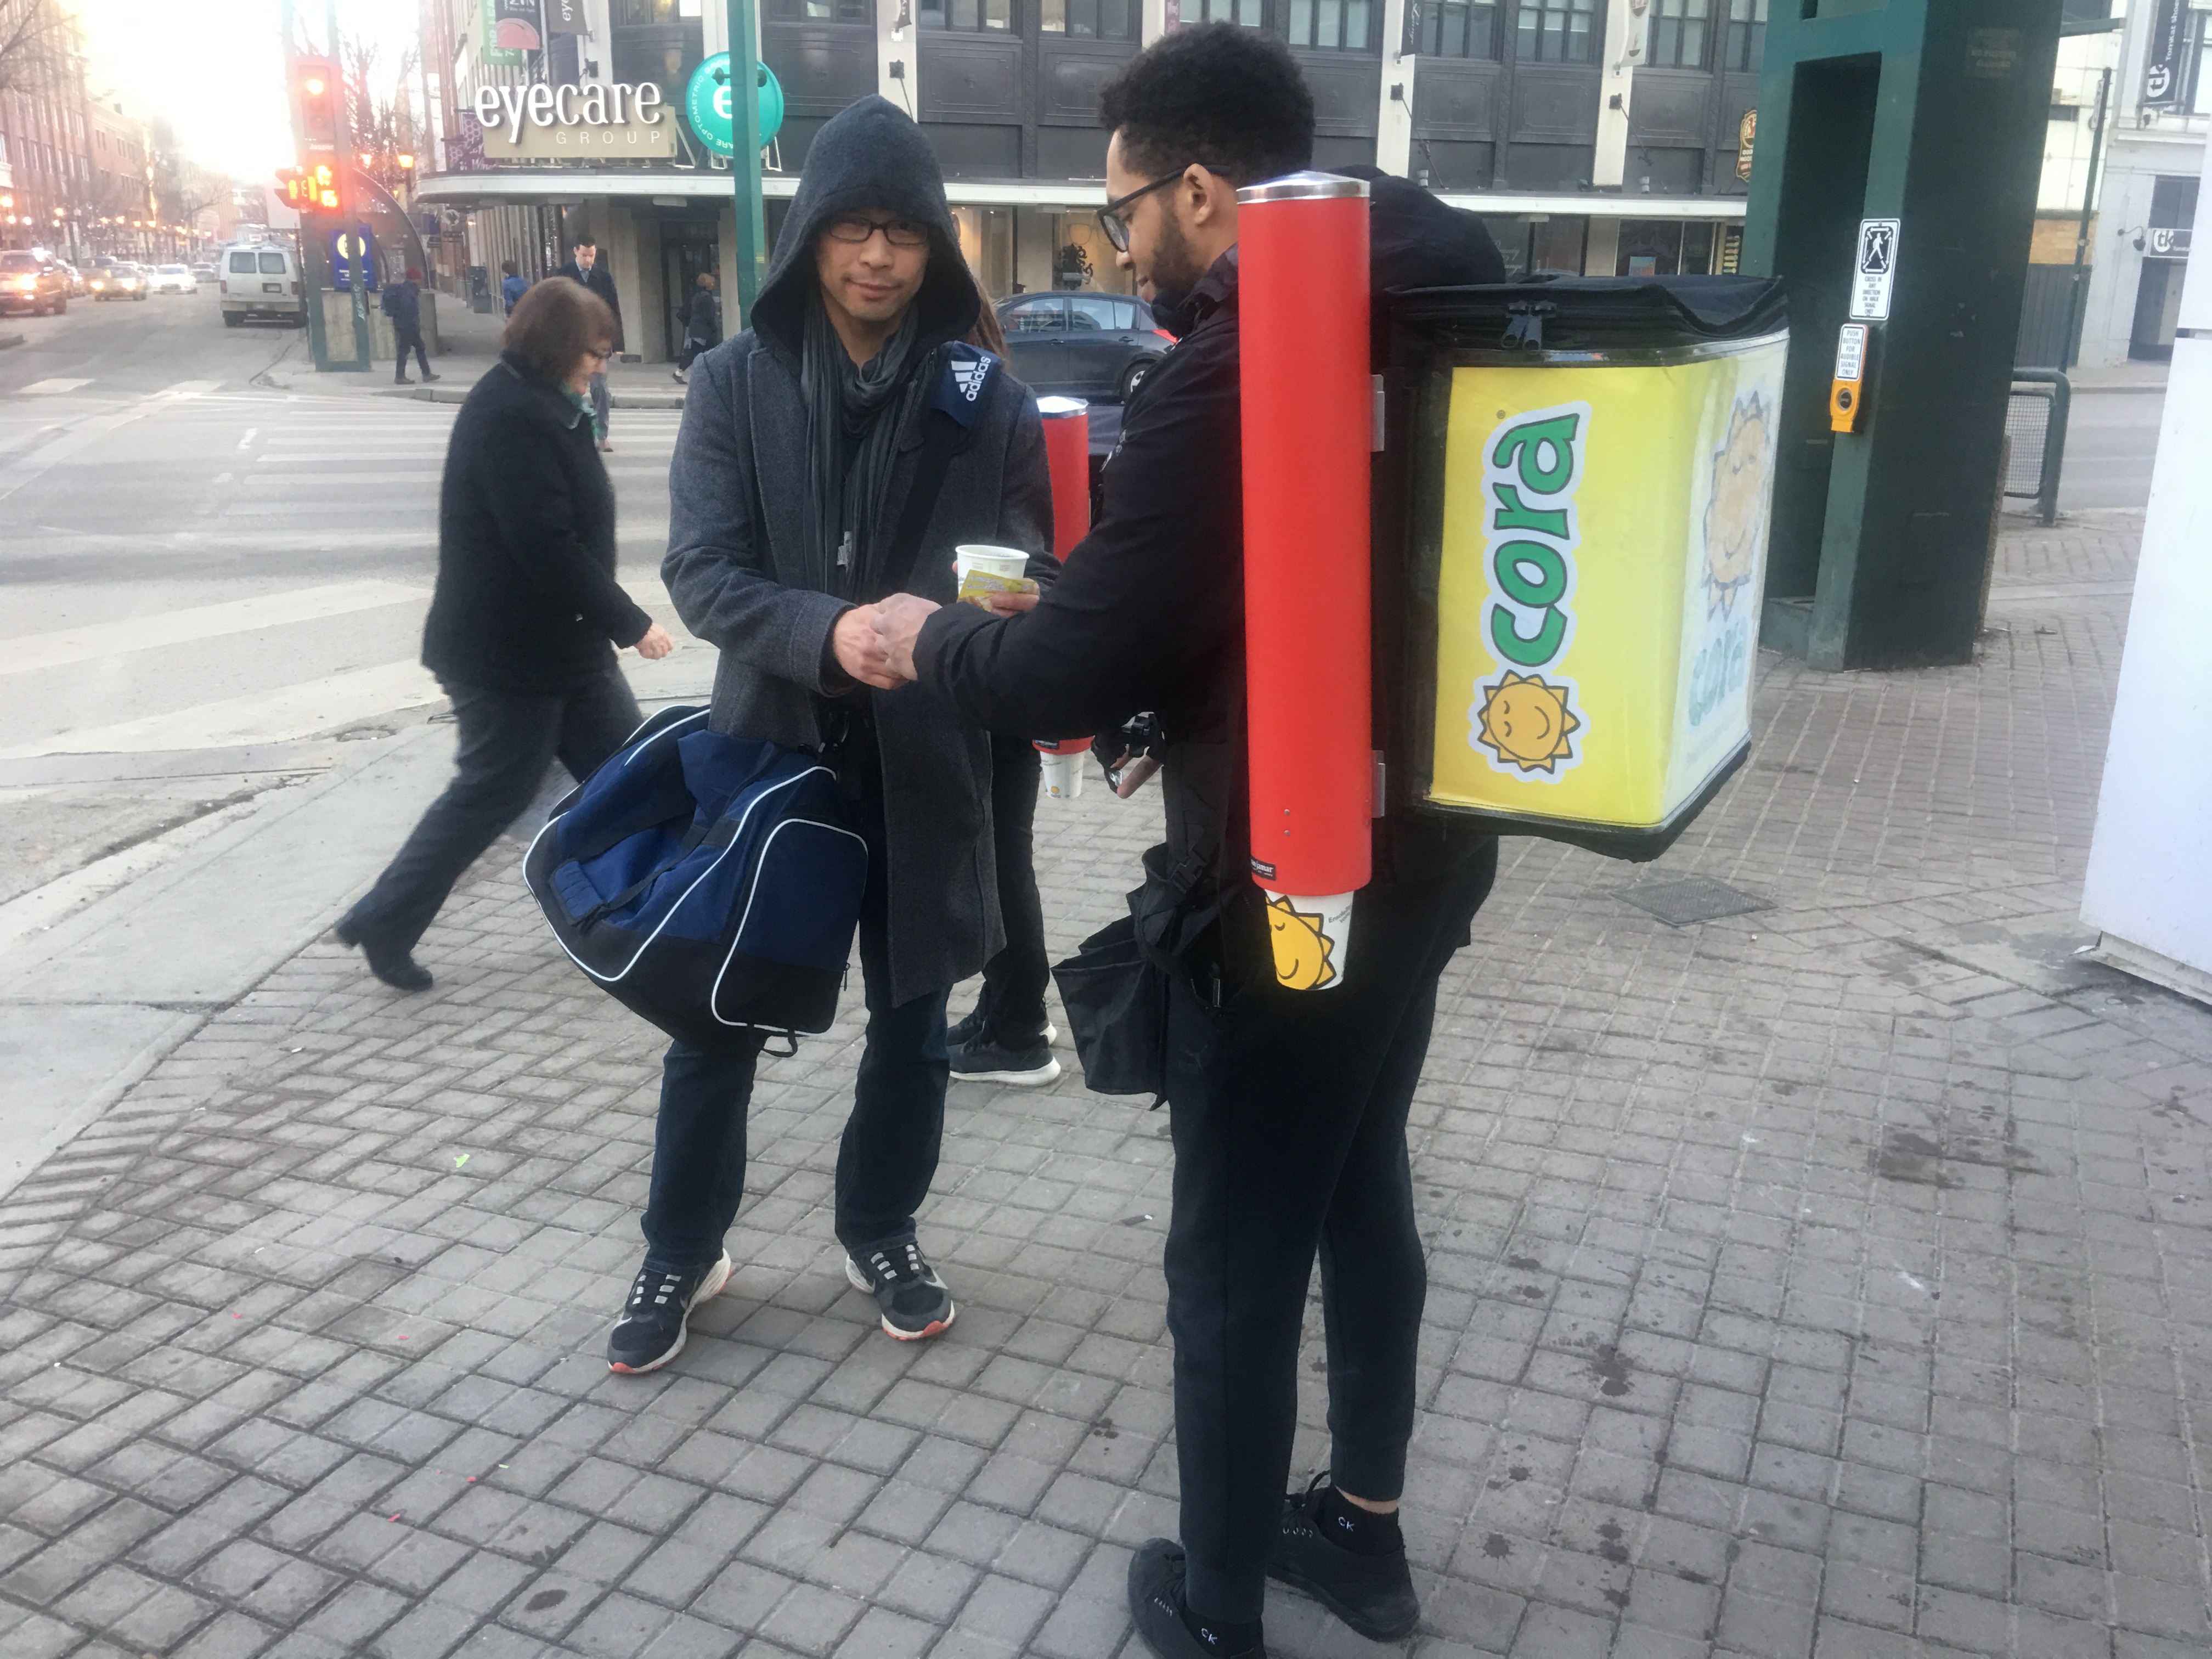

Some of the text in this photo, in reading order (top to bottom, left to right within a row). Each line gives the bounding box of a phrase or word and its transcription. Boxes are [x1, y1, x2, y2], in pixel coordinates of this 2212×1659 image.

[2165, 25, 2176, 62] TomKat
[475, 82, 661, 143] eyecare
[691, 75, 713, 139] OPTOMETRIC
[704, 58, 730, 74] GROU
[556, 131, 661, 144] GROUP
[966, 356, 991, 401] adidas
[1491, 413, 1579, 667] cora
[1338, 1516, 1355, 1532] CK
[1201, 1628, 1218, 1645] CK
